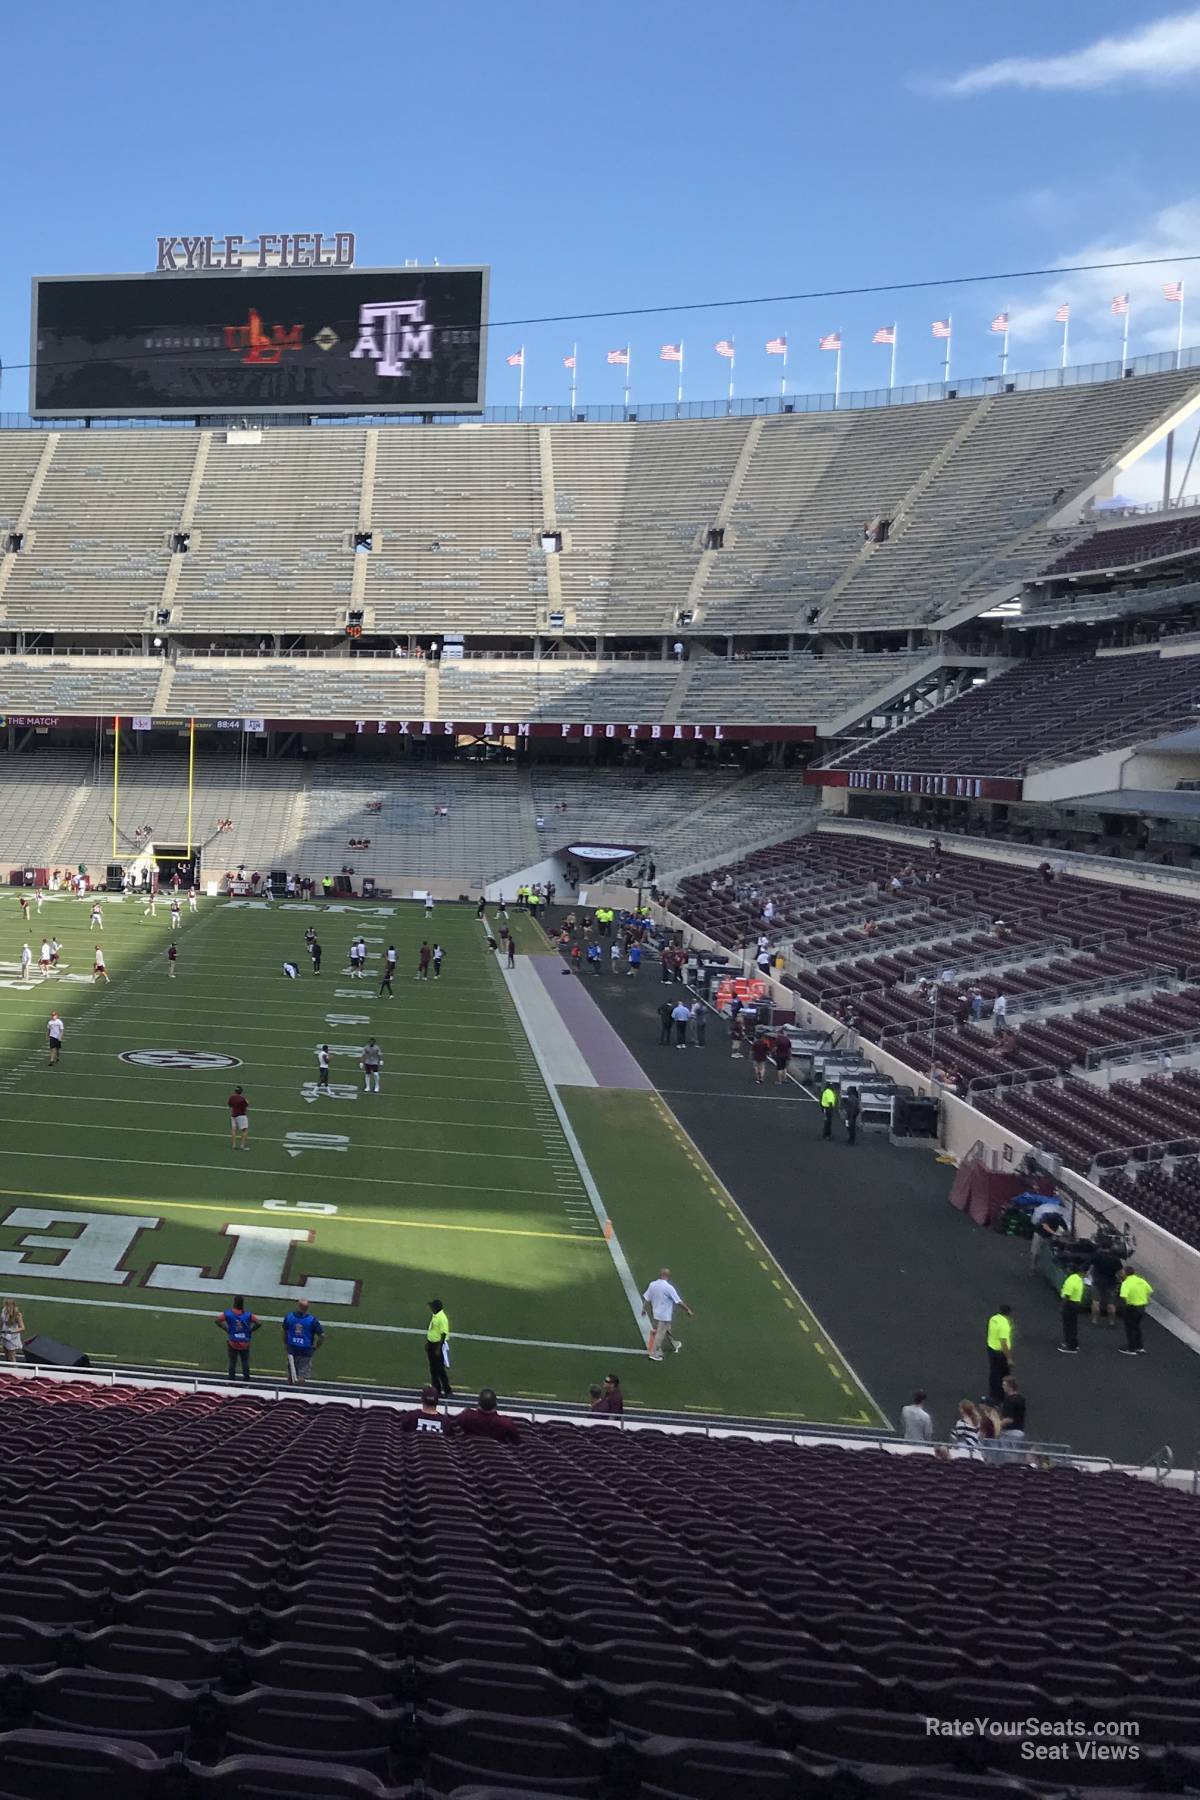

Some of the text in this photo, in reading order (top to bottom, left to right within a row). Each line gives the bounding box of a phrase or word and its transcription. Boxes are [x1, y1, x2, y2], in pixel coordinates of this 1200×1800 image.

[156, 232, 355, 271] KYLE FIELD
[8, 717, 25, 725] THE
[26, 717, 57, 726] MATCH
[355, 721, 724, 739] TEXAS A&M FOOTBALL
